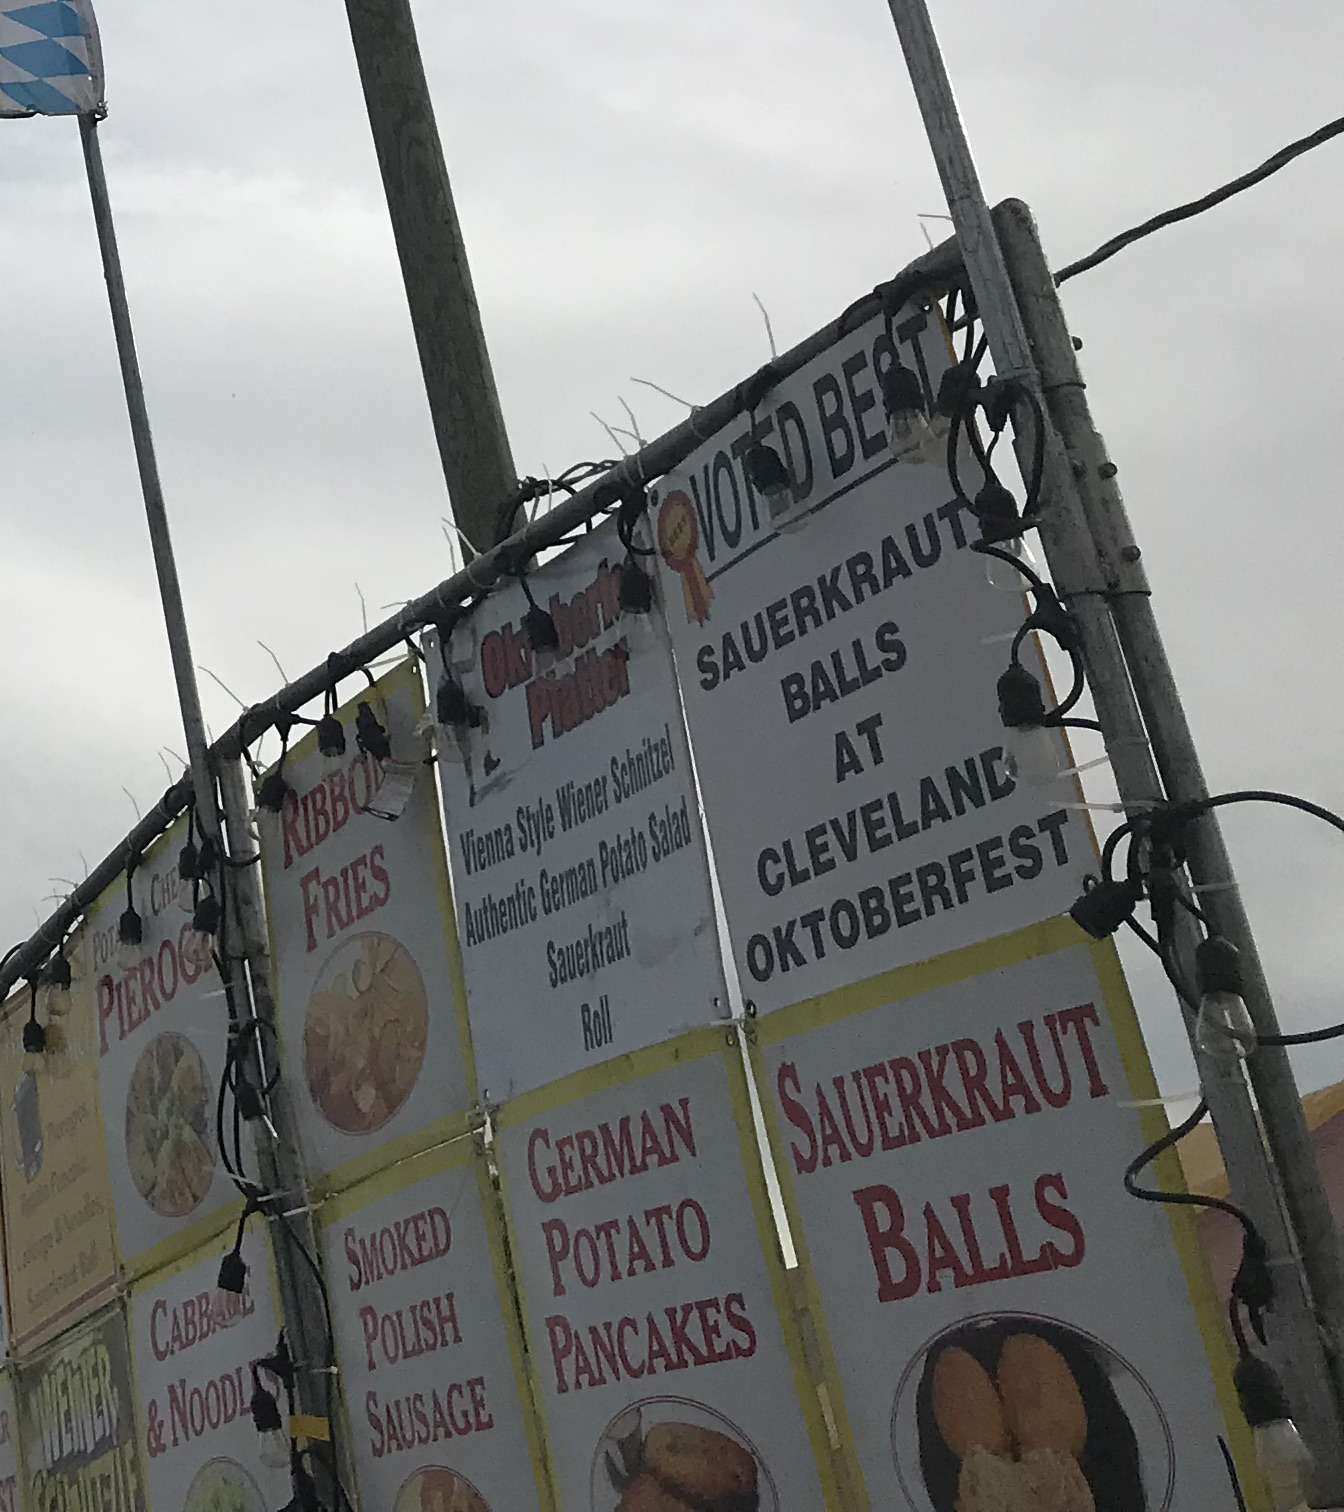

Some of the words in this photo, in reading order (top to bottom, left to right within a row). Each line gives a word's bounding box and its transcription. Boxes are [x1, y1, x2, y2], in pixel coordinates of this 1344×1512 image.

[697, 496, 980, 691] SAUERKRAUT
[781, 621, 908, 724] BALLS
[459, 823, 516, 876] Vienna
[516, 796, 555, 856] Style
[556, 774, 609, 832] Wiener
[611, 722, 675, 804] Schnitzel
[835, 712, 884, 783] AT
[464, 878, 538, 948] Authentic
[539, 857, 598, 916] German
[598, 826, 648, 888] Potato
[648, 794, 692, 863] Salad
[757, 746, 1017, 897] CLEVELAND
[300, 843, 390, 953] FRIES
[747, 809, 1069, 982] OKTOBERFEST
[546, 910, 632, 989] Sauerkraut
[580, 994, 613, 1051] Roll
[777, 1002, 1110, 1175] SAUERKRAUT
[527, 1097, 697, 1204] GERMAN
[344, 1206, 452, 1292] SMOKED
[541, 1198, 711, 1298] POTATO
[852, 1173, 1086, 1304] BALLS
[359, 1292, 462, 1372] POLISH
[545, 1292, 757, 1394] PANCAKES
[146, 1399, 167, 1458] &
[365, 1376, 494, 1458] SAUSAGE
